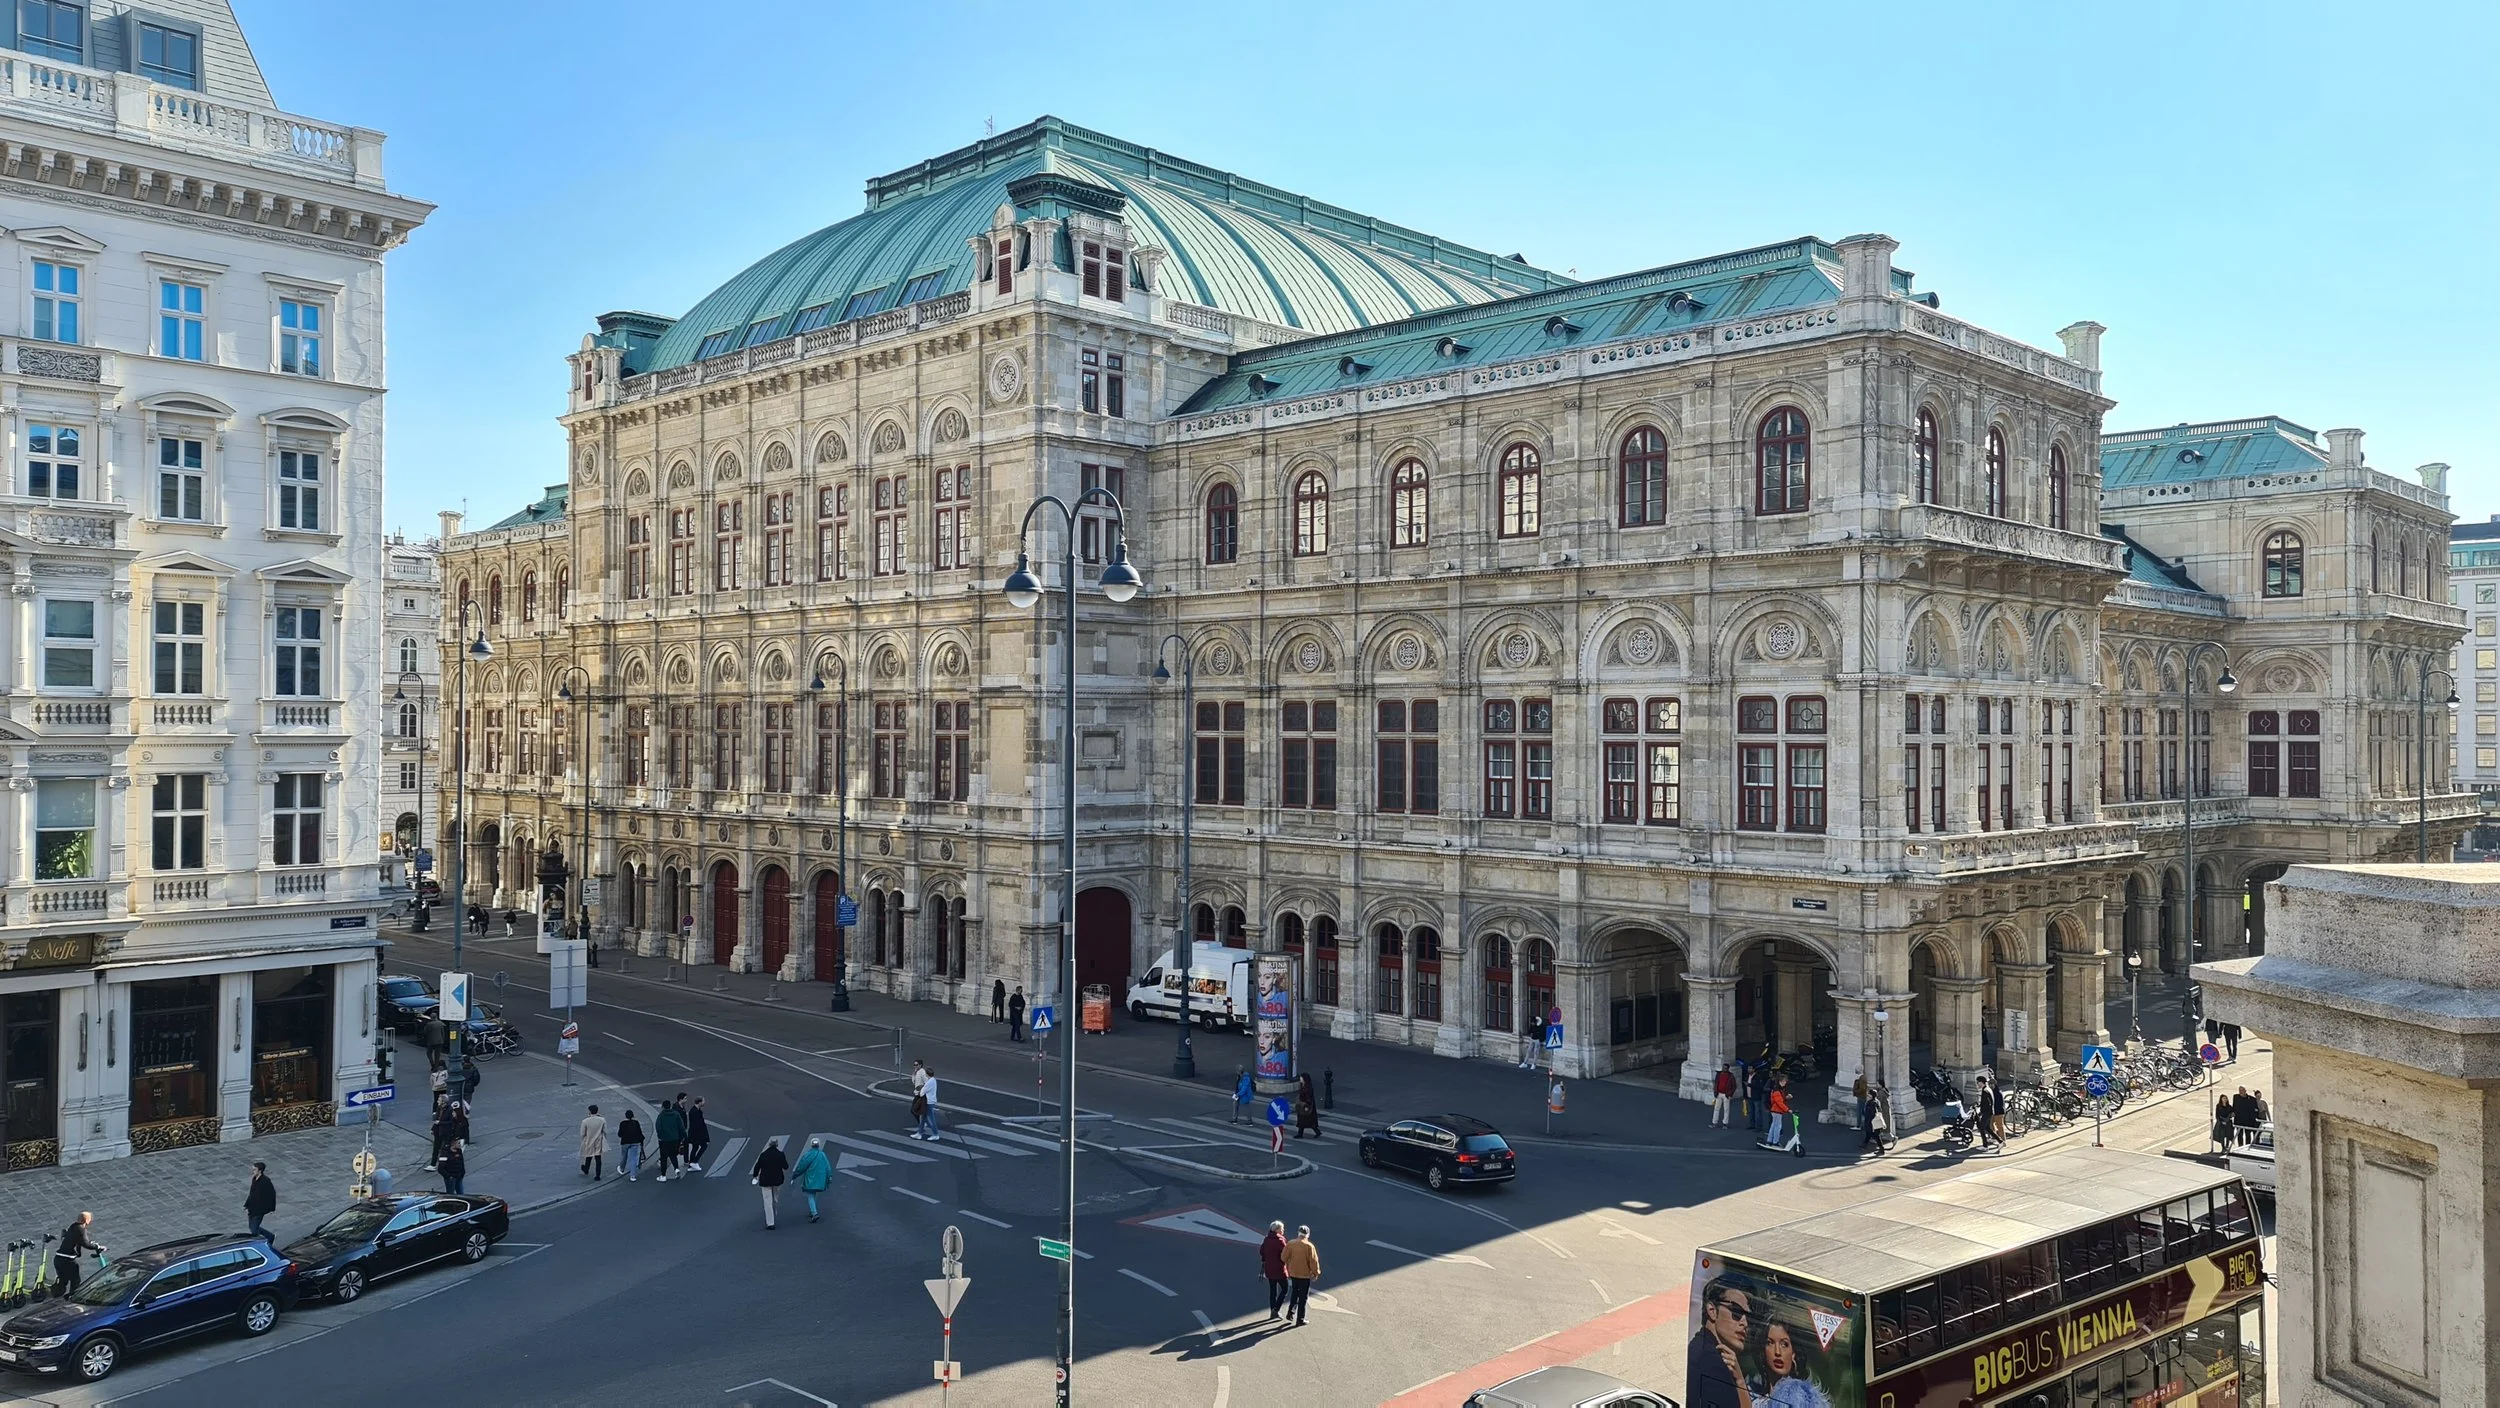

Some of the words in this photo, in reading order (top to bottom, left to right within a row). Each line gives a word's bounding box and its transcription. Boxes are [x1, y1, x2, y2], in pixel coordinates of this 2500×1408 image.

[31, 949, 42, 960] &
[43, 940, 79, 960] Neffe
[363, 1090, 390, 1100] EINBAHN
[2229, 1253, 2244, 1276] BIG
[2230, 1272, 2246, 1292] BUS
[1813, 1312, 1840, 1327] GUESS
[2057, 1299, 2137, 1360] VIENNA
